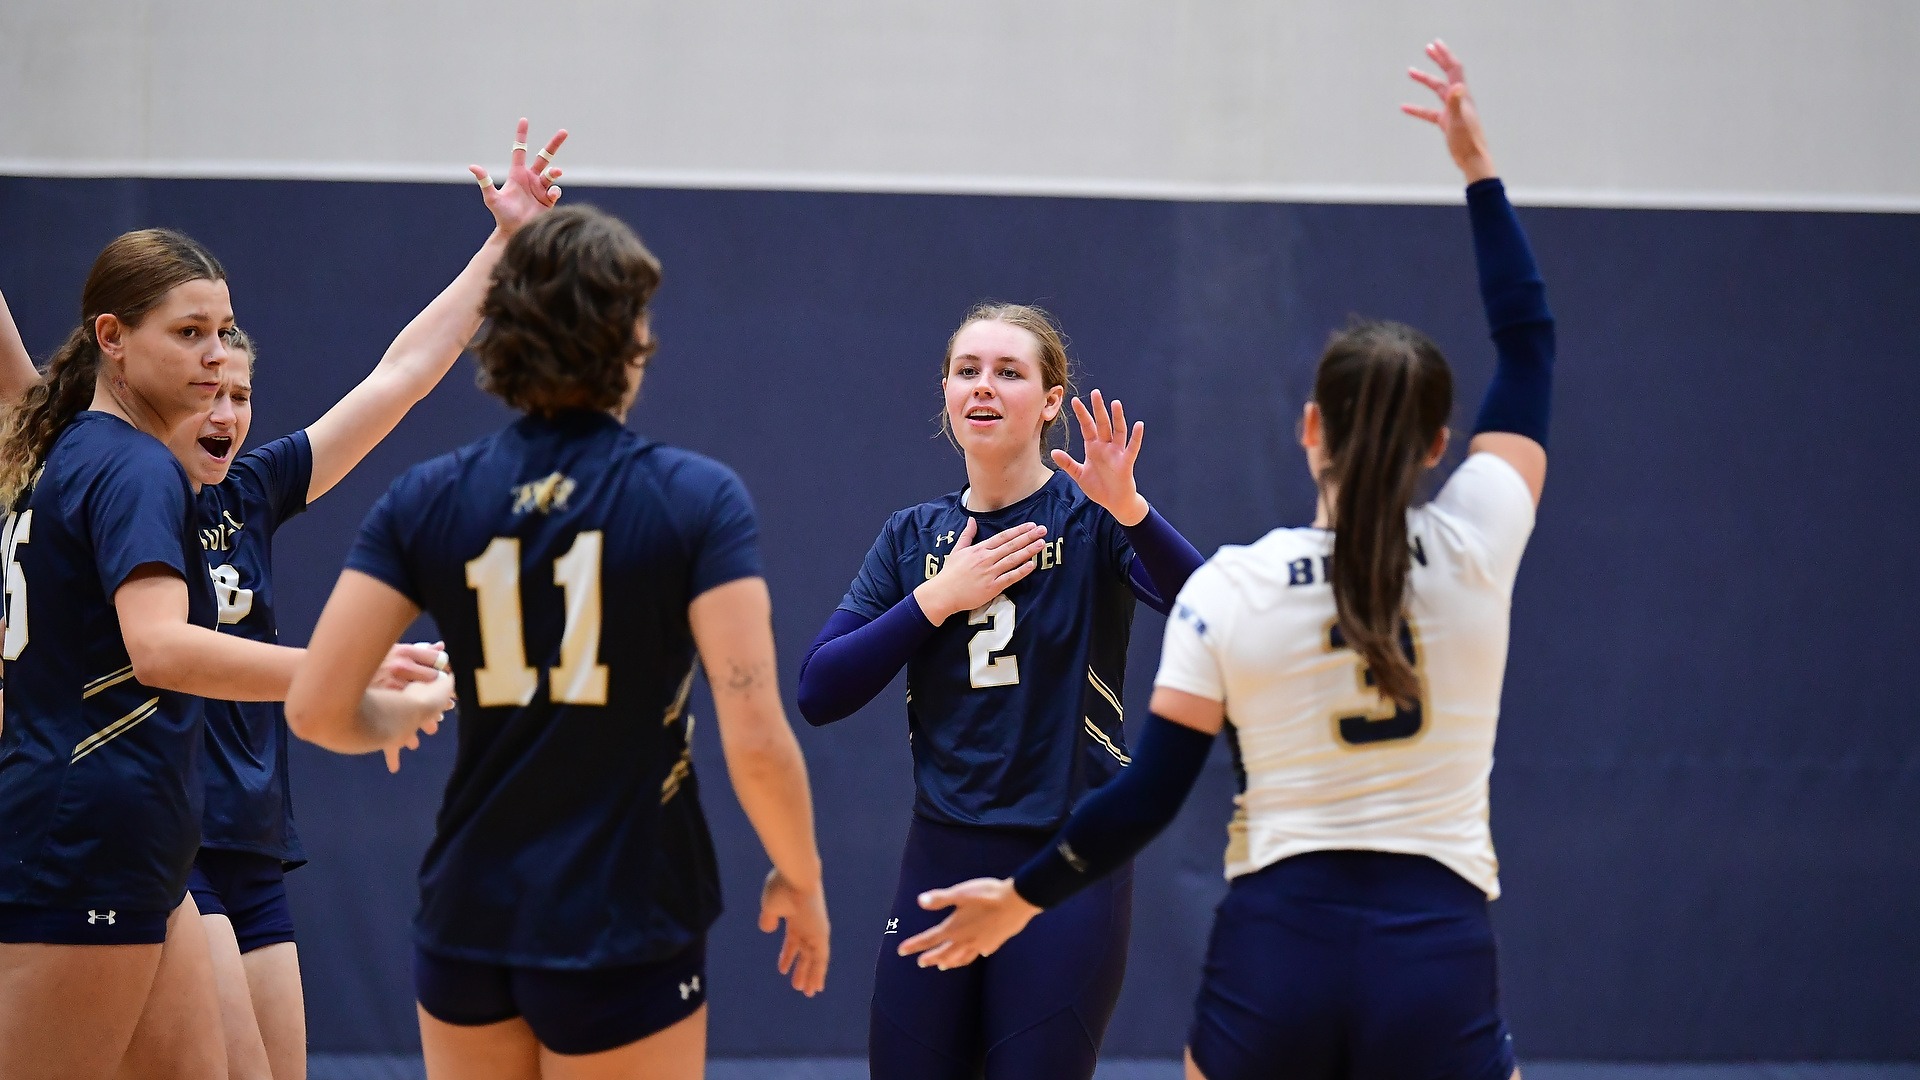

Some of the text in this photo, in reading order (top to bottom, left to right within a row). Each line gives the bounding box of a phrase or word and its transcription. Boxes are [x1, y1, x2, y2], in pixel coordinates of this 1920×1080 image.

[464, 529, 609, 707] 11
[967, 593, 1020, 689] 2
[1321, 608, 1431, 752] 3
